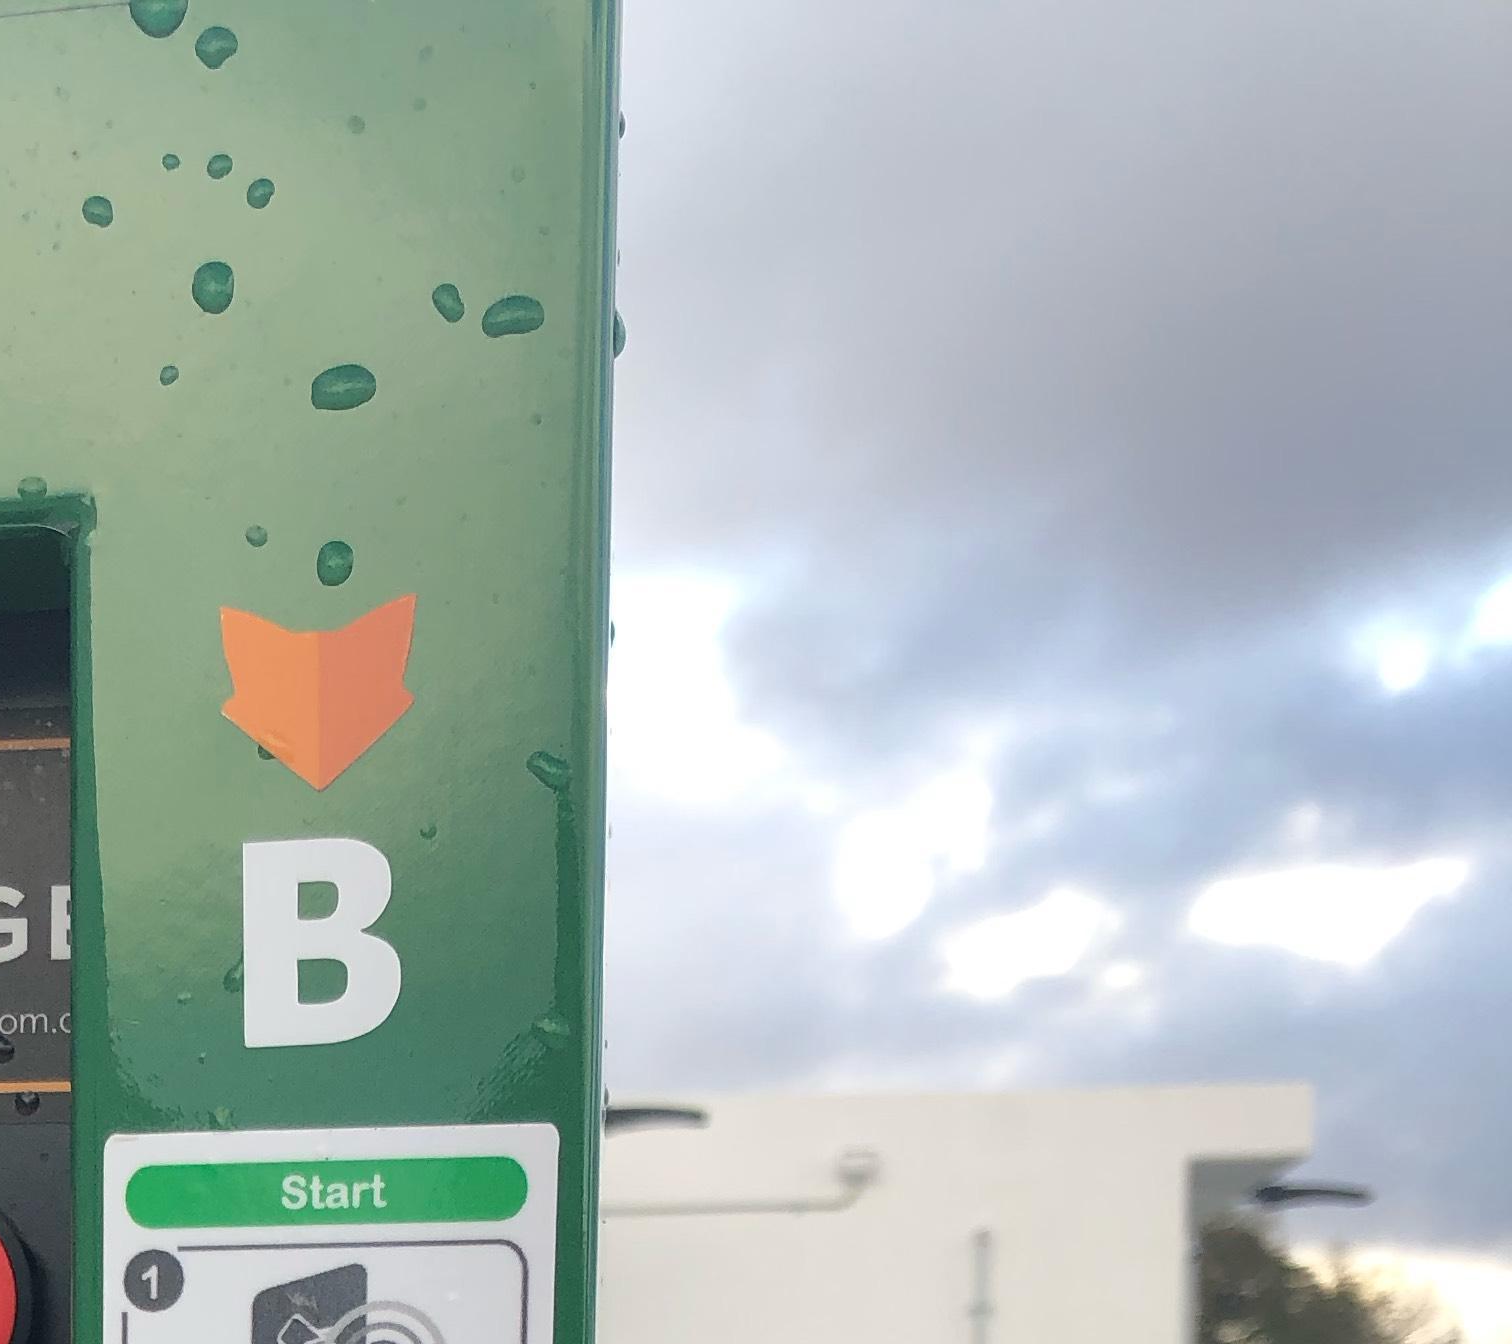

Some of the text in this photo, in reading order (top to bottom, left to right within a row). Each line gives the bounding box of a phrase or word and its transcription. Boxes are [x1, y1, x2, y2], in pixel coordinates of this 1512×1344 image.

[242, 836, 402, 1049] B
[280, 1172, 388, 1211] Start
[141, 1264, 160, 1300] 1
